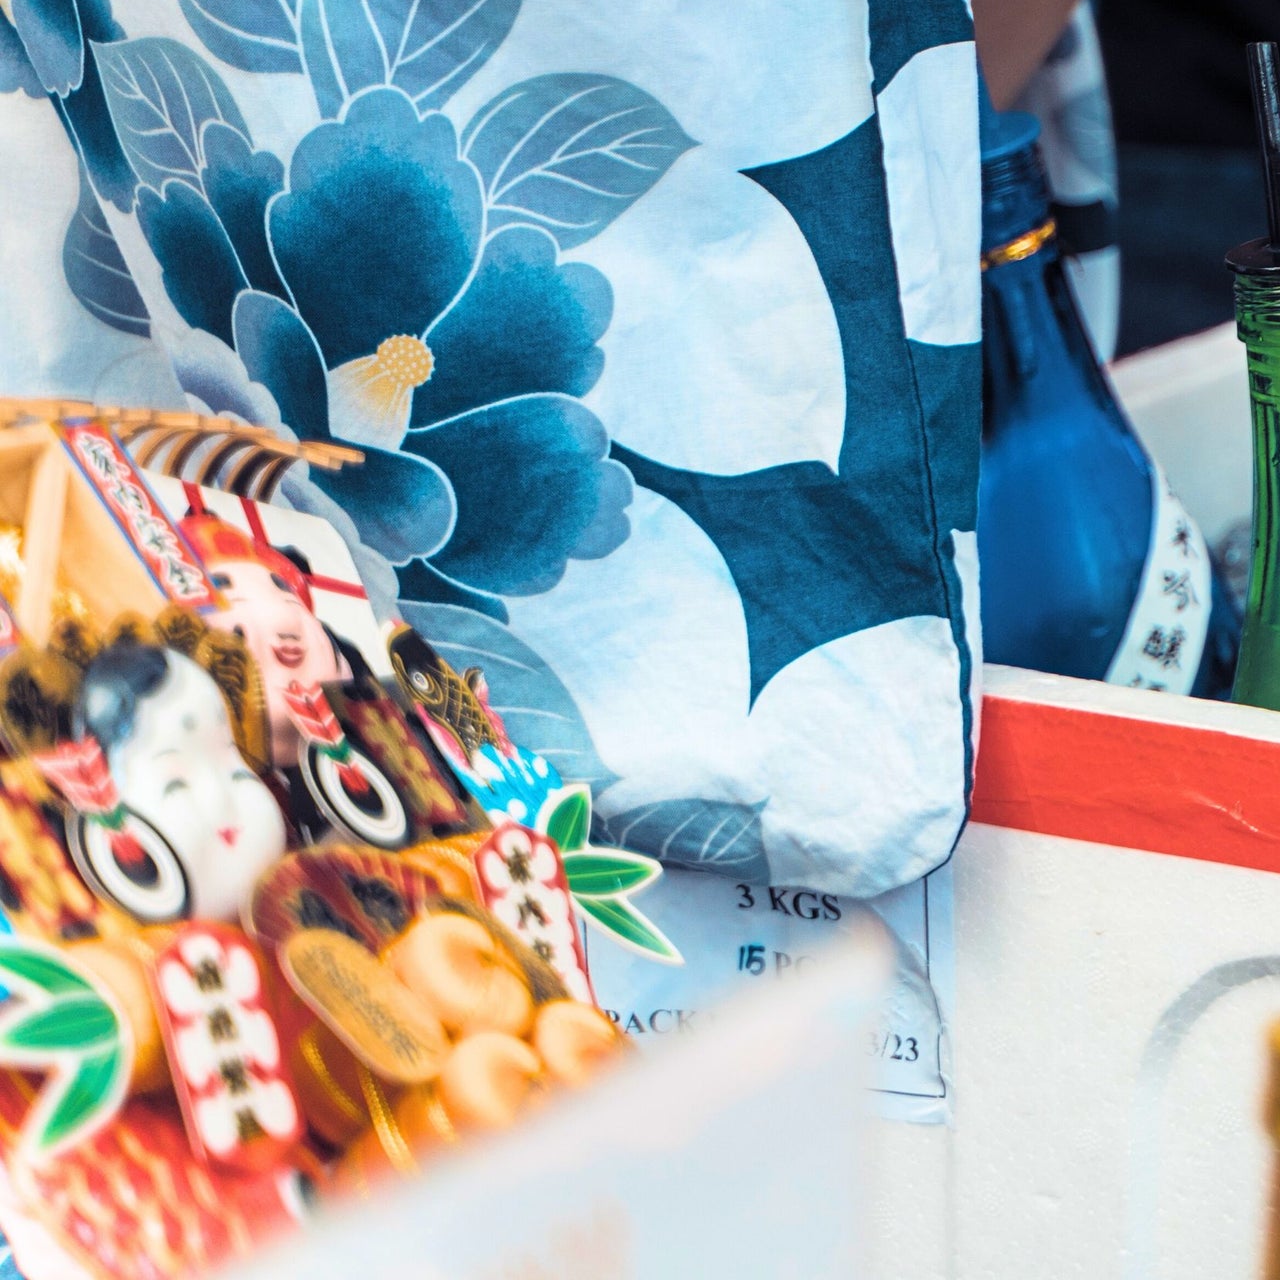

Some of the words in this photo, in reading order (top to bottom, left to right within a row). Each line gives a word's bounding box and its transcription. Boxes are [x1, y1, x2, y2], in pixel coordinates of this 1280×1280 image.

[735, 883, 756, 909] 3
[767, 885, 843, 922] KGS
[738, 943, 767, 976] 15
